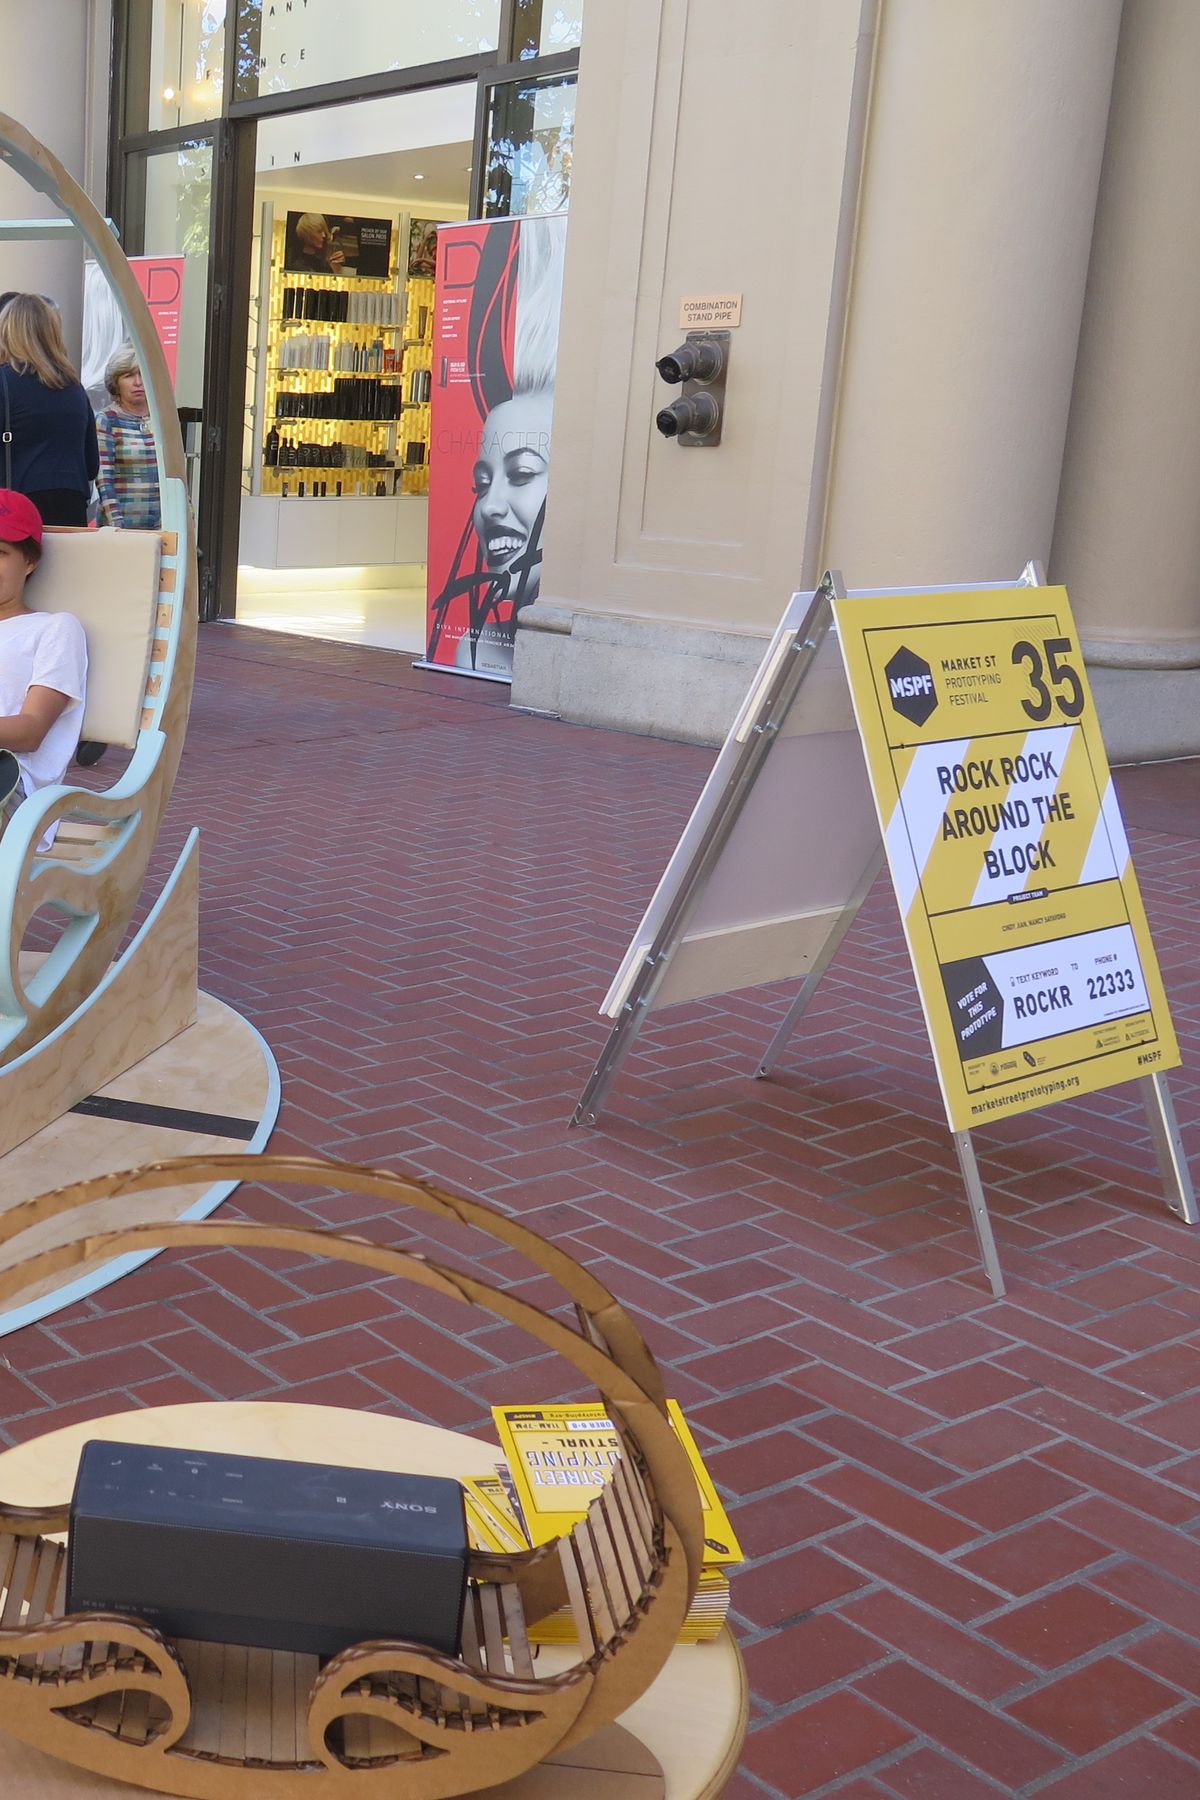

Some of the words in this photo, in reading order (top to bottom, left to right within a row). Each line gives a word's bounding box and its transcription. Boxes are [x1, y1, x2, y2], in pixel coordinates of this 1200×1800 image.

[683, 300, 738, 311] COMBINATION
[687, 313, 713, 322] STAND
[714, 311, 732, 320] PIPE
[436, 430, 550, 456] CHARACTER
[454, 626, 511, 640] INTERNATIONAL
[941, 657, 982, 672] MARKET
[984, 655, 997, 668] ST
[890, 674, 933, 699] MSPF
[945, 673, 1002, 689] PROTOTYPING
[1012, 638, 1085, 722] 35
[949, 692, 989, 706] FESTIVAL
[936, 759, 1000, 795] ROCK
[1000, 751, 1059, 785] ROCK
[942, 799, 1030, 841] AROUND
[1032, 792, 1075, 824] THE
[983, 840, 1056, 879] BLOCK
[1015, 974, 1031, 984] TEXT
[1031, 967, 1059, 981] KEYWORD
[1070, 962, 1079, 971] TO
[1094, 955, 1113, 965] PHONE
[957, 991, 976, 1010] VOTE
[973, 982, 988, 999] FOR
[1013, 985, 1073, 1019] ROCKR
[1086, 968, 1135, 1000] 22333
[968, 1001, 984, 1019] THIS
[960, 1006, 997, 1041] PROTOTYPE
[1137, 1050, 1162, 1066] #MSPF
[971, 1075, 1080, 1115] marketstreetprototyping.org
[589, 1421, 611, 1429] OBER
[559, 1438, 619, 1448] STIVAL
[527, 1450, 622, 1467] OTYPING
[534, 1470, 605, 1486] STREET
[380, 1500, 437, 1514] SONY
